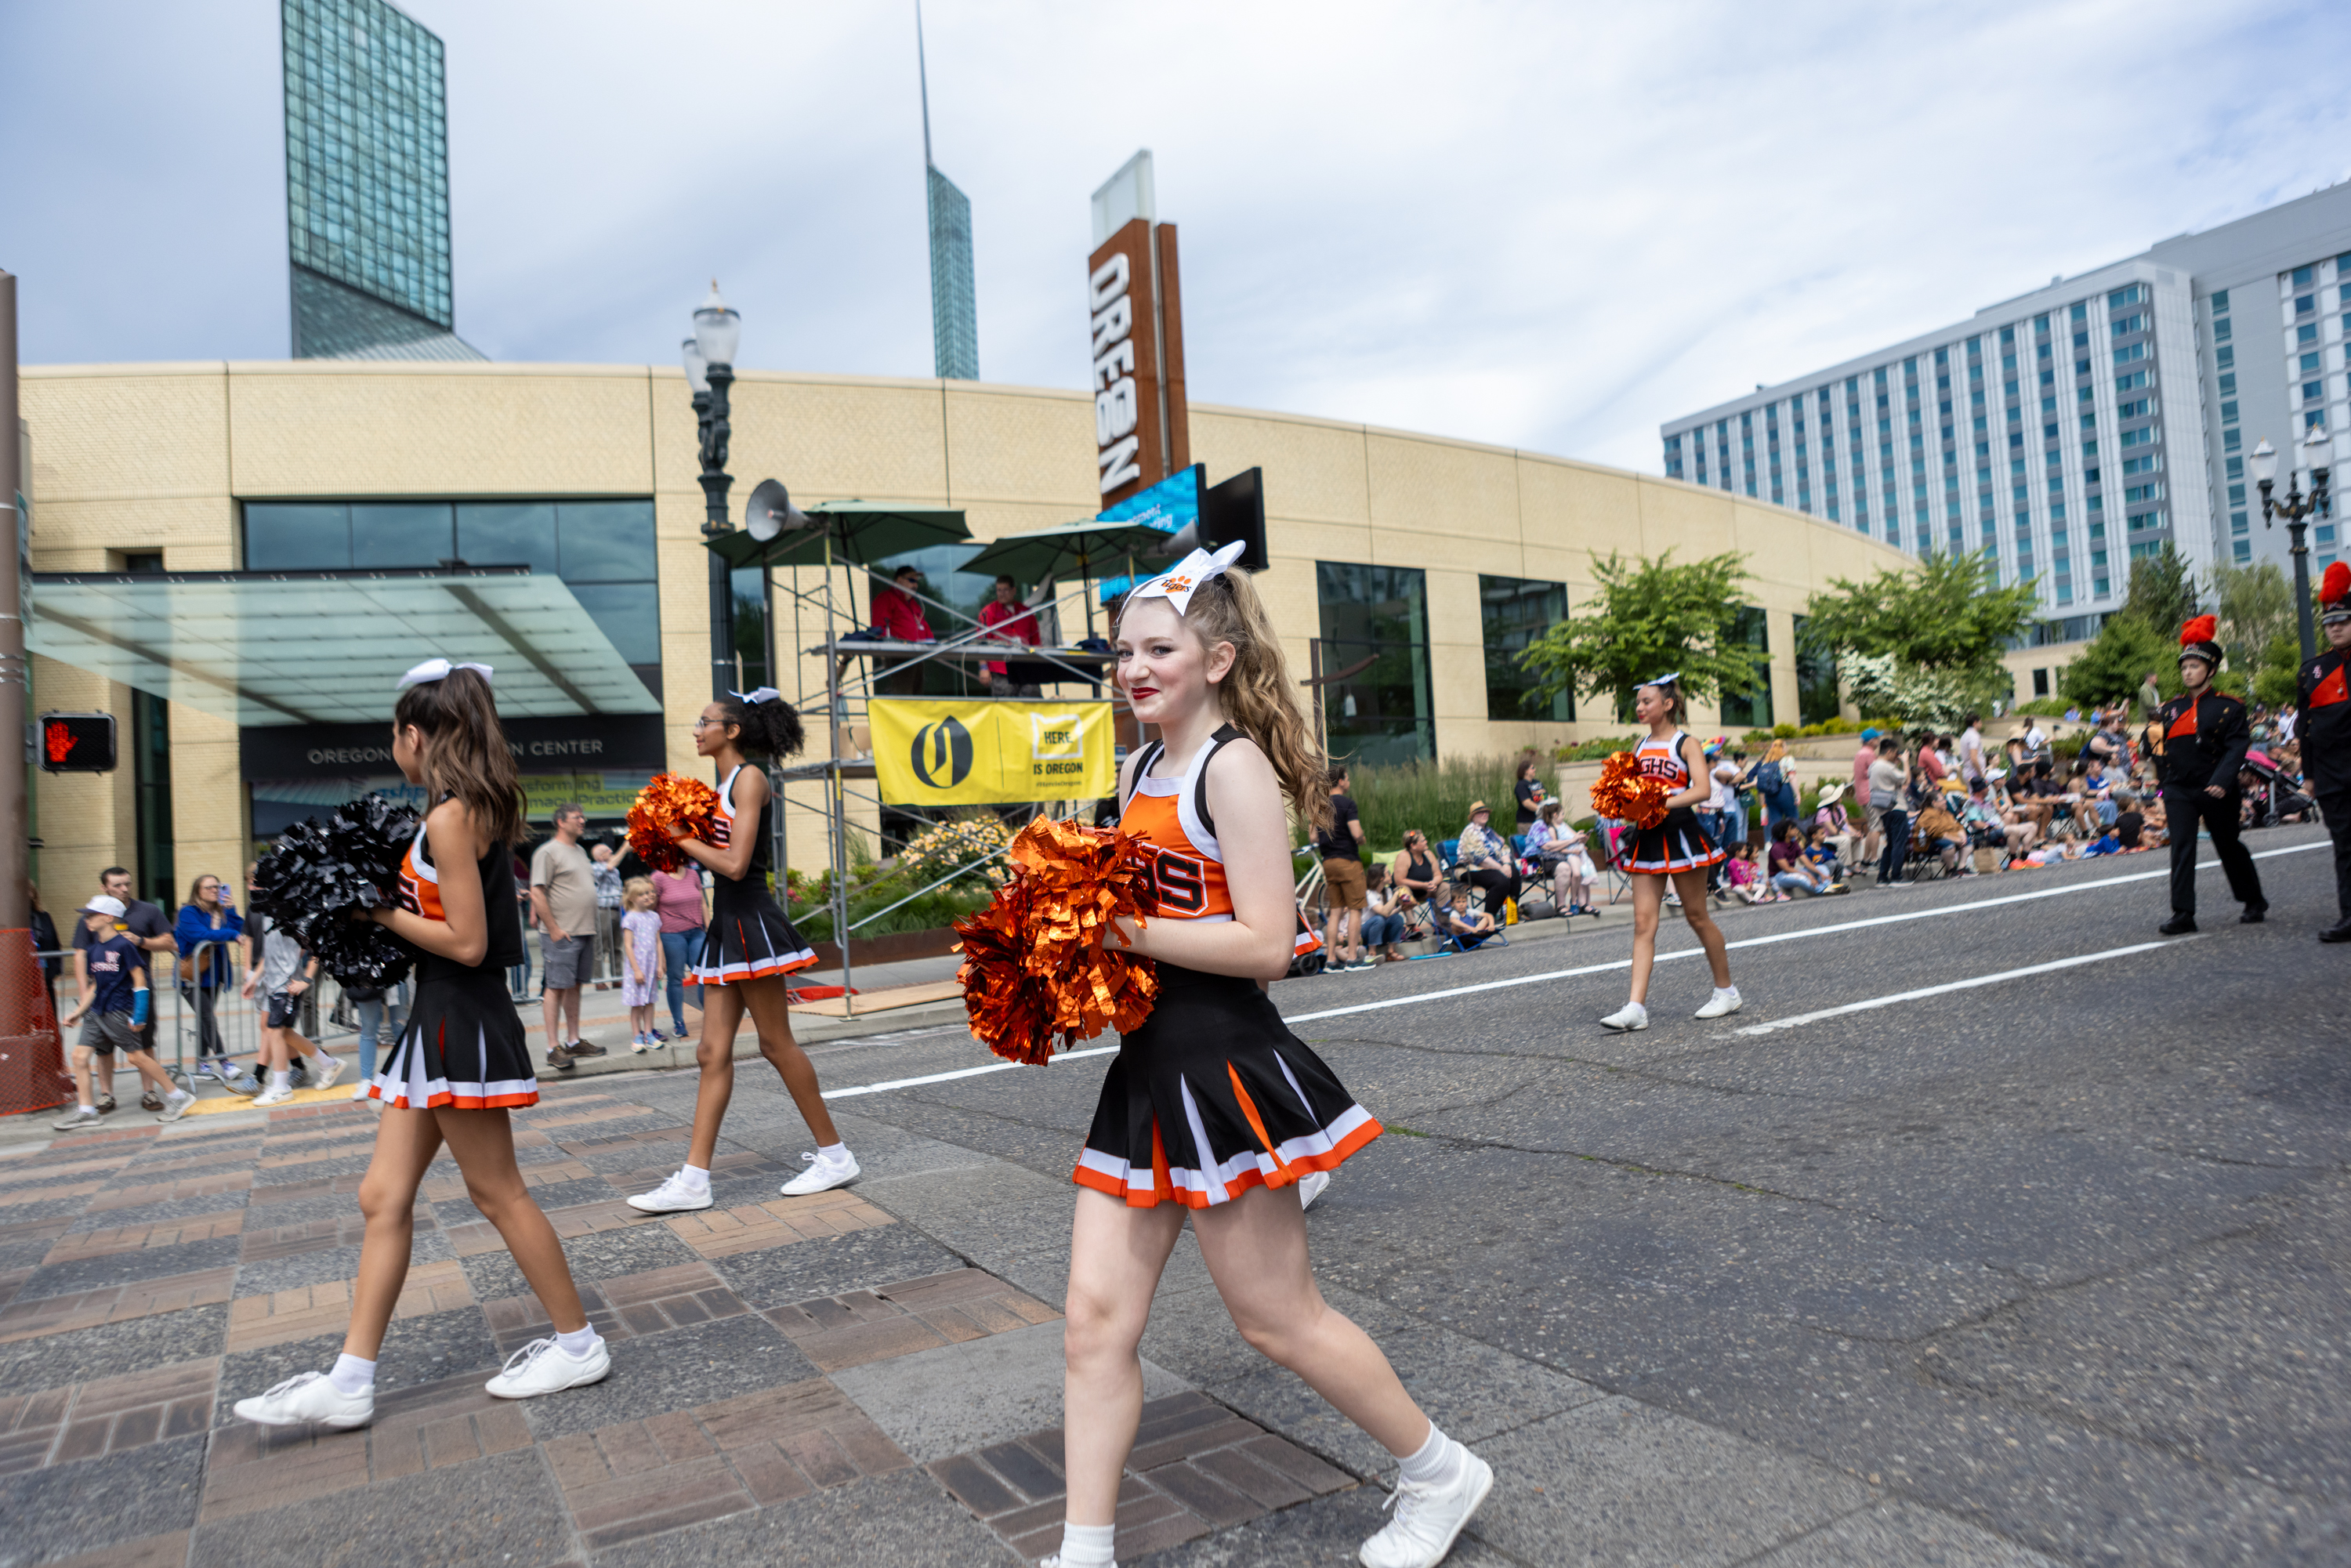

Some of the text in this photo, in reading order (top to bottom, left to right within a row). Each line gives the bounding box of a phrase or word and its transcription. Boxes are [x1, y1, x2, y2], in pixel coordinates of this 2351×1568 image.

[1161, 578, 1192, 592] Tigers
[1044, 731, 1074, 744] HERE
[530, 739, 603, 756] CENTER
[307, 747, 391, 764] OREGON
[1034, 762, 1083, 775] IS OREGON
[520, 777, 602, 793] nsforming
[578, 791, 639, 806] Practic
